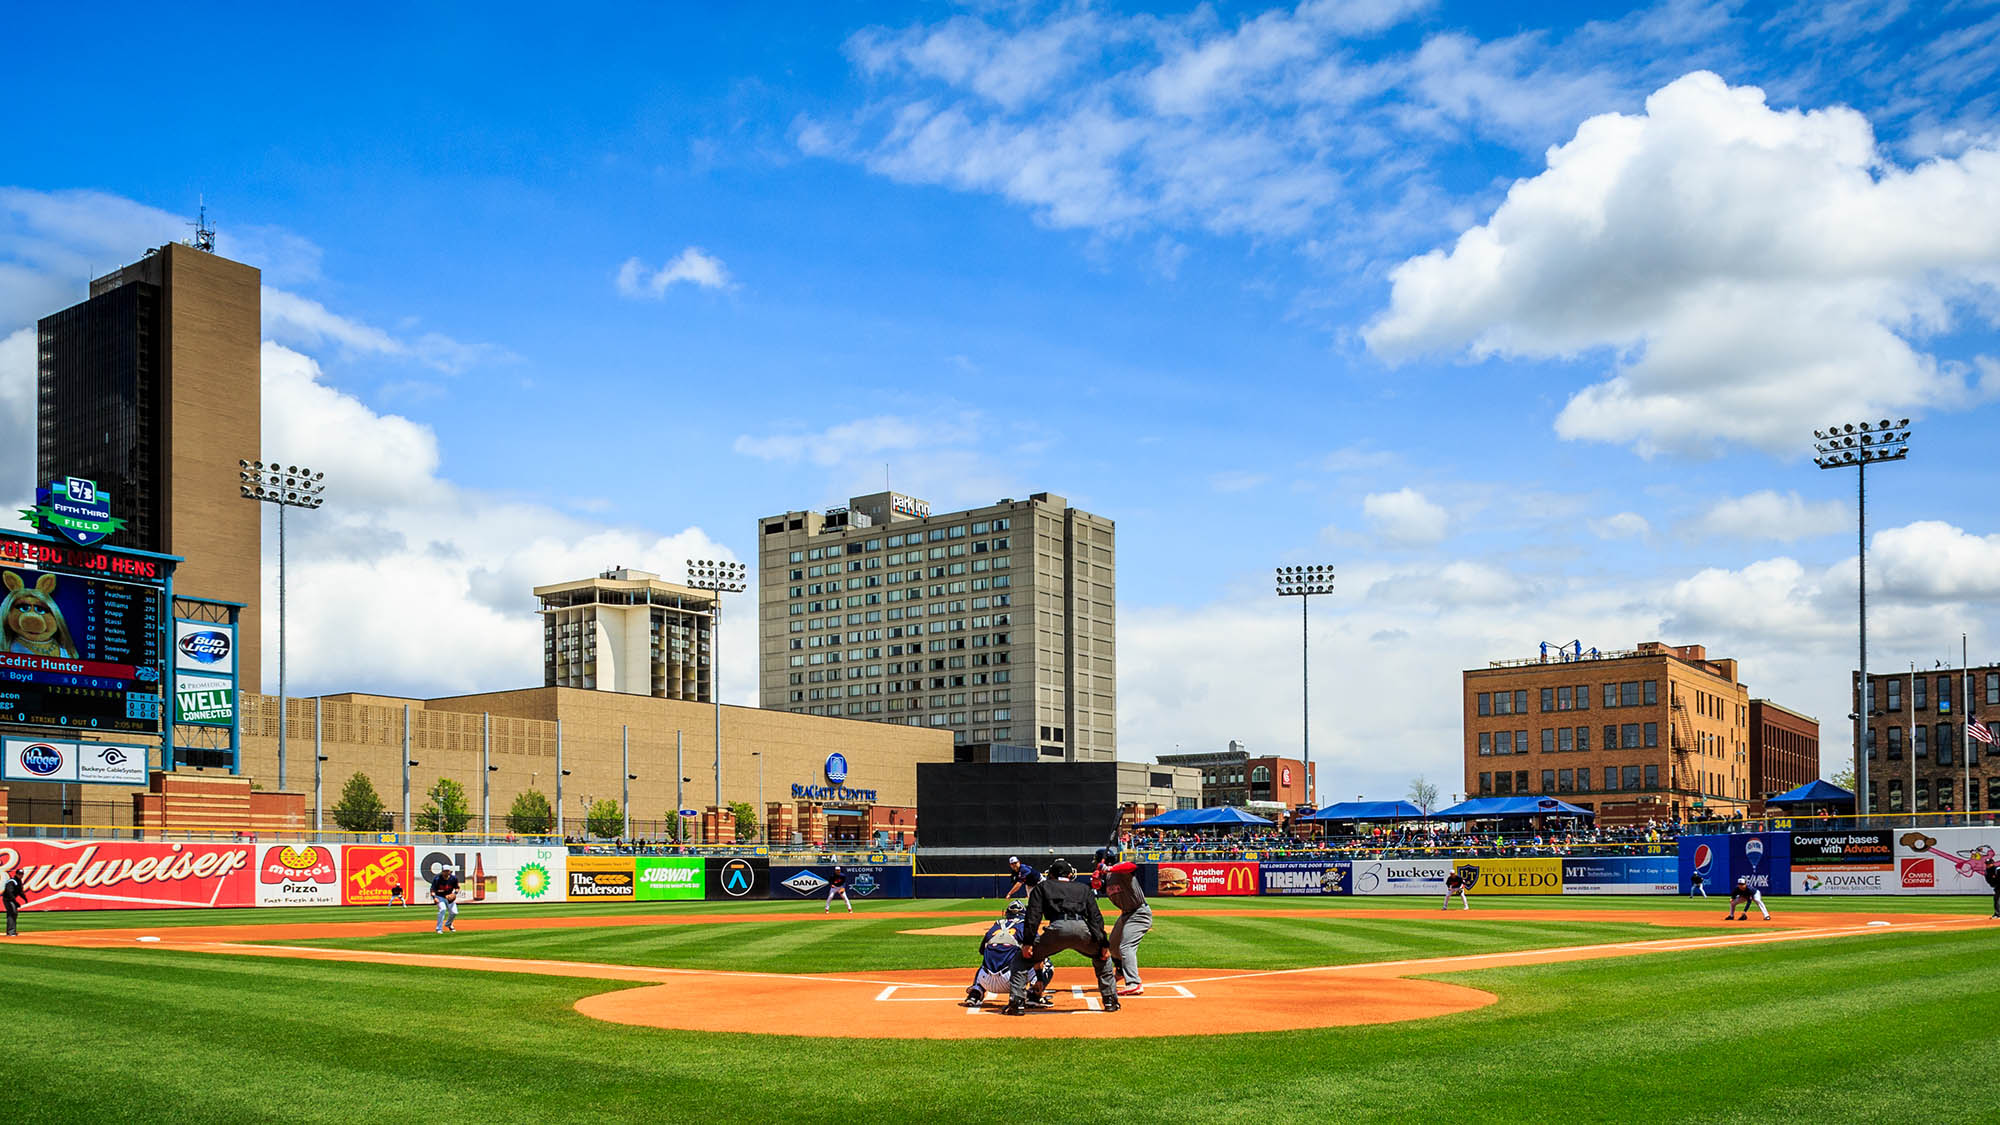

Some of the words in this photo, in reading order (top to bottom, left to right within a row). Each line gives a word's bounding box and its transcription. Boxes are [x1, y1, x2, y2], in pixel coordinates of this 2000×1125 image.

[54, 503, 80, 514] FIFTH
[80, 507, 109, 518] THIRD
[892, 495, 914, 511] park
[915, 499, 930, 515] inn
[64, 518, 99, 530] FIELD
[112, 556, 156, 578] HENS
[194, 636, 225, 647] BUD
[186, 643, 228, 655] LIGHT
[0, 655, 37, 668] Cedric
[41, 659, 84, 672] Hunter
[9, 672, 33, 683] Boyd
[71, 677, 77, 685] 0
[92, 679, 98, 687] 0
[177, 691, 232, 712] WELL
[18, 713, 25, 722] 0
[60, 716, 67, 725] 0
[91, 718, 97, 727] 0
[183, 709, 232, 721] CONNECTED
[26, 748, 60, 771] Kroger
[81, 766, 105, 774] Buckeye
[1775, 820, 1792, 828] 344
[1794, 836, 1824, 845] Cover
[1825, 837, 1847, 846] your
[1848, 835, 1879, 844] bases
[537, 848, 552, 861] bp
[1821, 845, 1842, 853] with
[1844, 844, 1890, 853] Advance.
[350, 851, 404, 889] TAS
[640, 867, 700, 882] SUBWAY
[1192, 868, 1224, 876] Another
[1387, 867, 1445, 880] buckeye
[1460, 870, 1476, 881] UT
[1565, 867, 1585, 877] MT
[571, 873, 594, 885] The
[1192, 876, 1225, 885] Winning
[1265, 871, 1321, 888] TIREMAN
[1481, 873, 1558, 887] TOLEDO
[1825, 876, 1880, 885] ADVANCE
[283, 883, 318, 893] Pizza
[571, 883, 633, 895] Andersons
